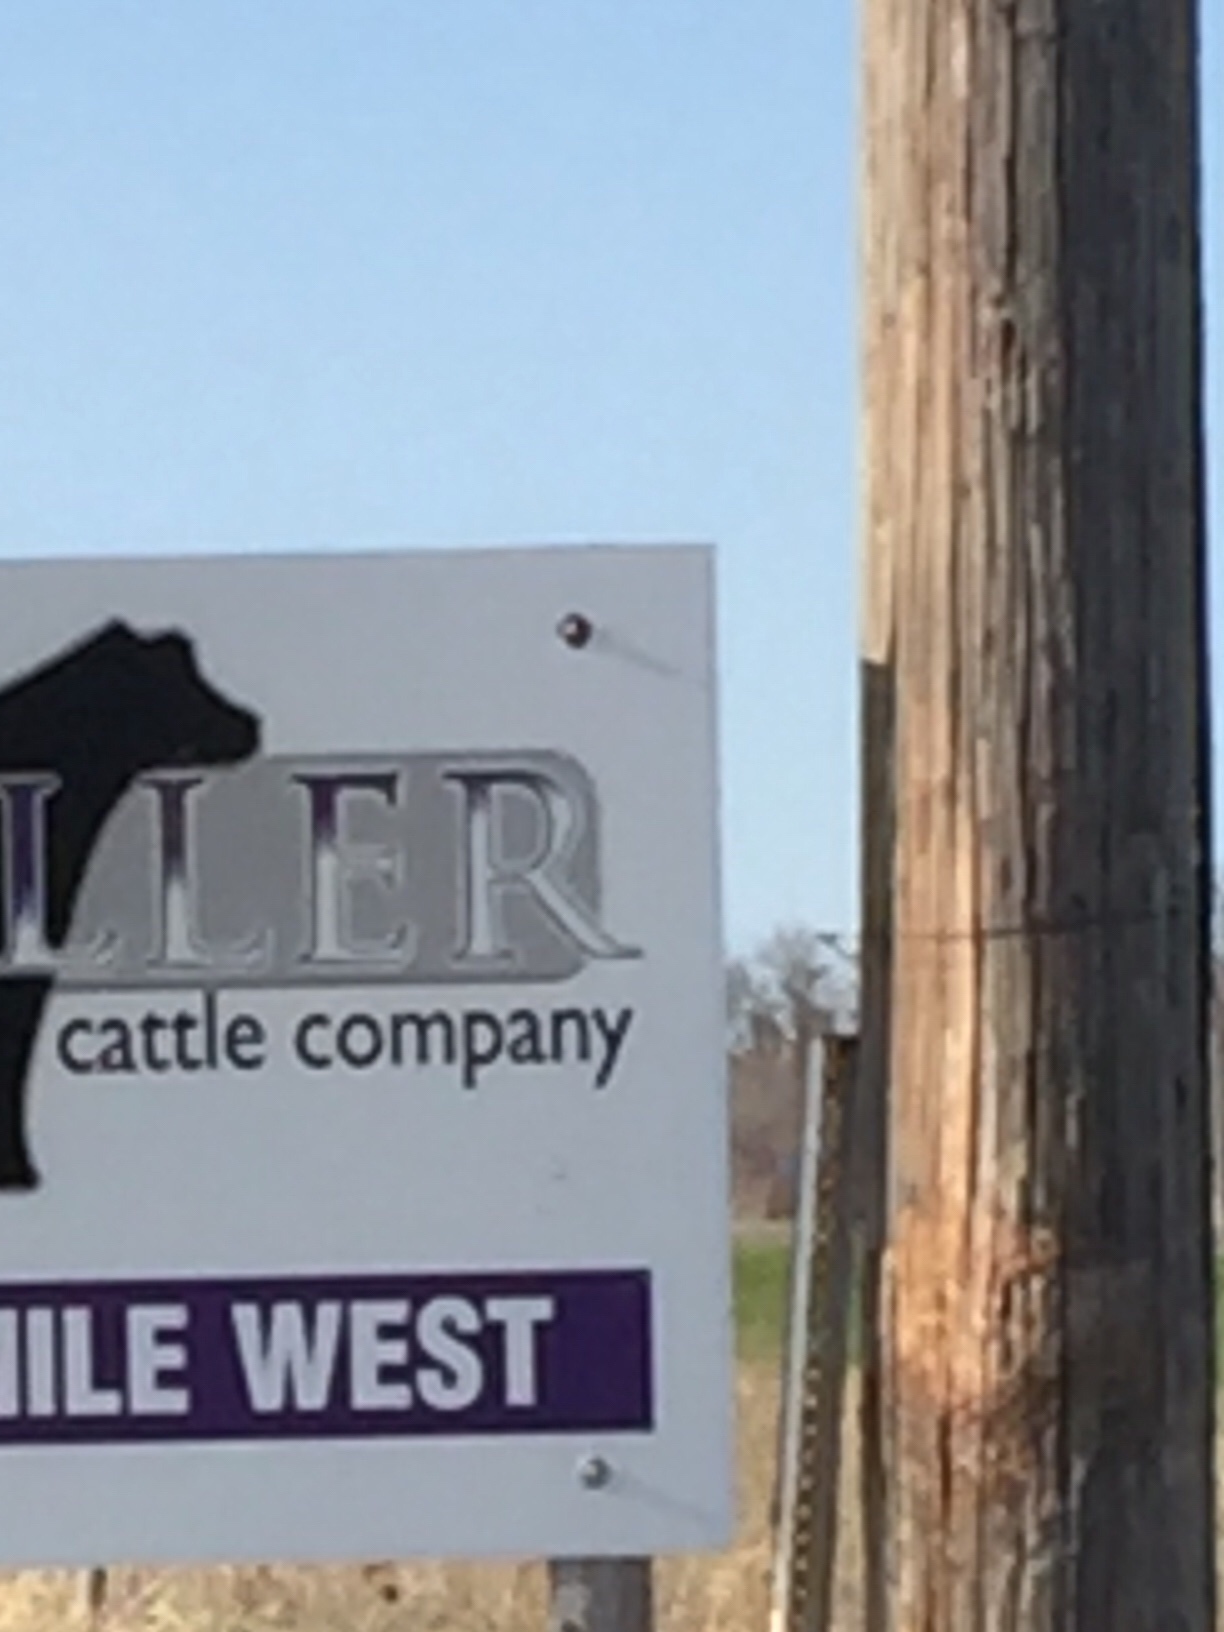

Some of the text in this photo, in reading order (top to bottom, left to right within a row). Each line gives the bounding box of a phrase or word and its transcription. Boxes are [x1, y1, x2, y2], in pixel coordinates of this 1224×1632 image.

[57, 992, 632, 1088] cattle company
[233, 1296, 555, 1413] WEST
